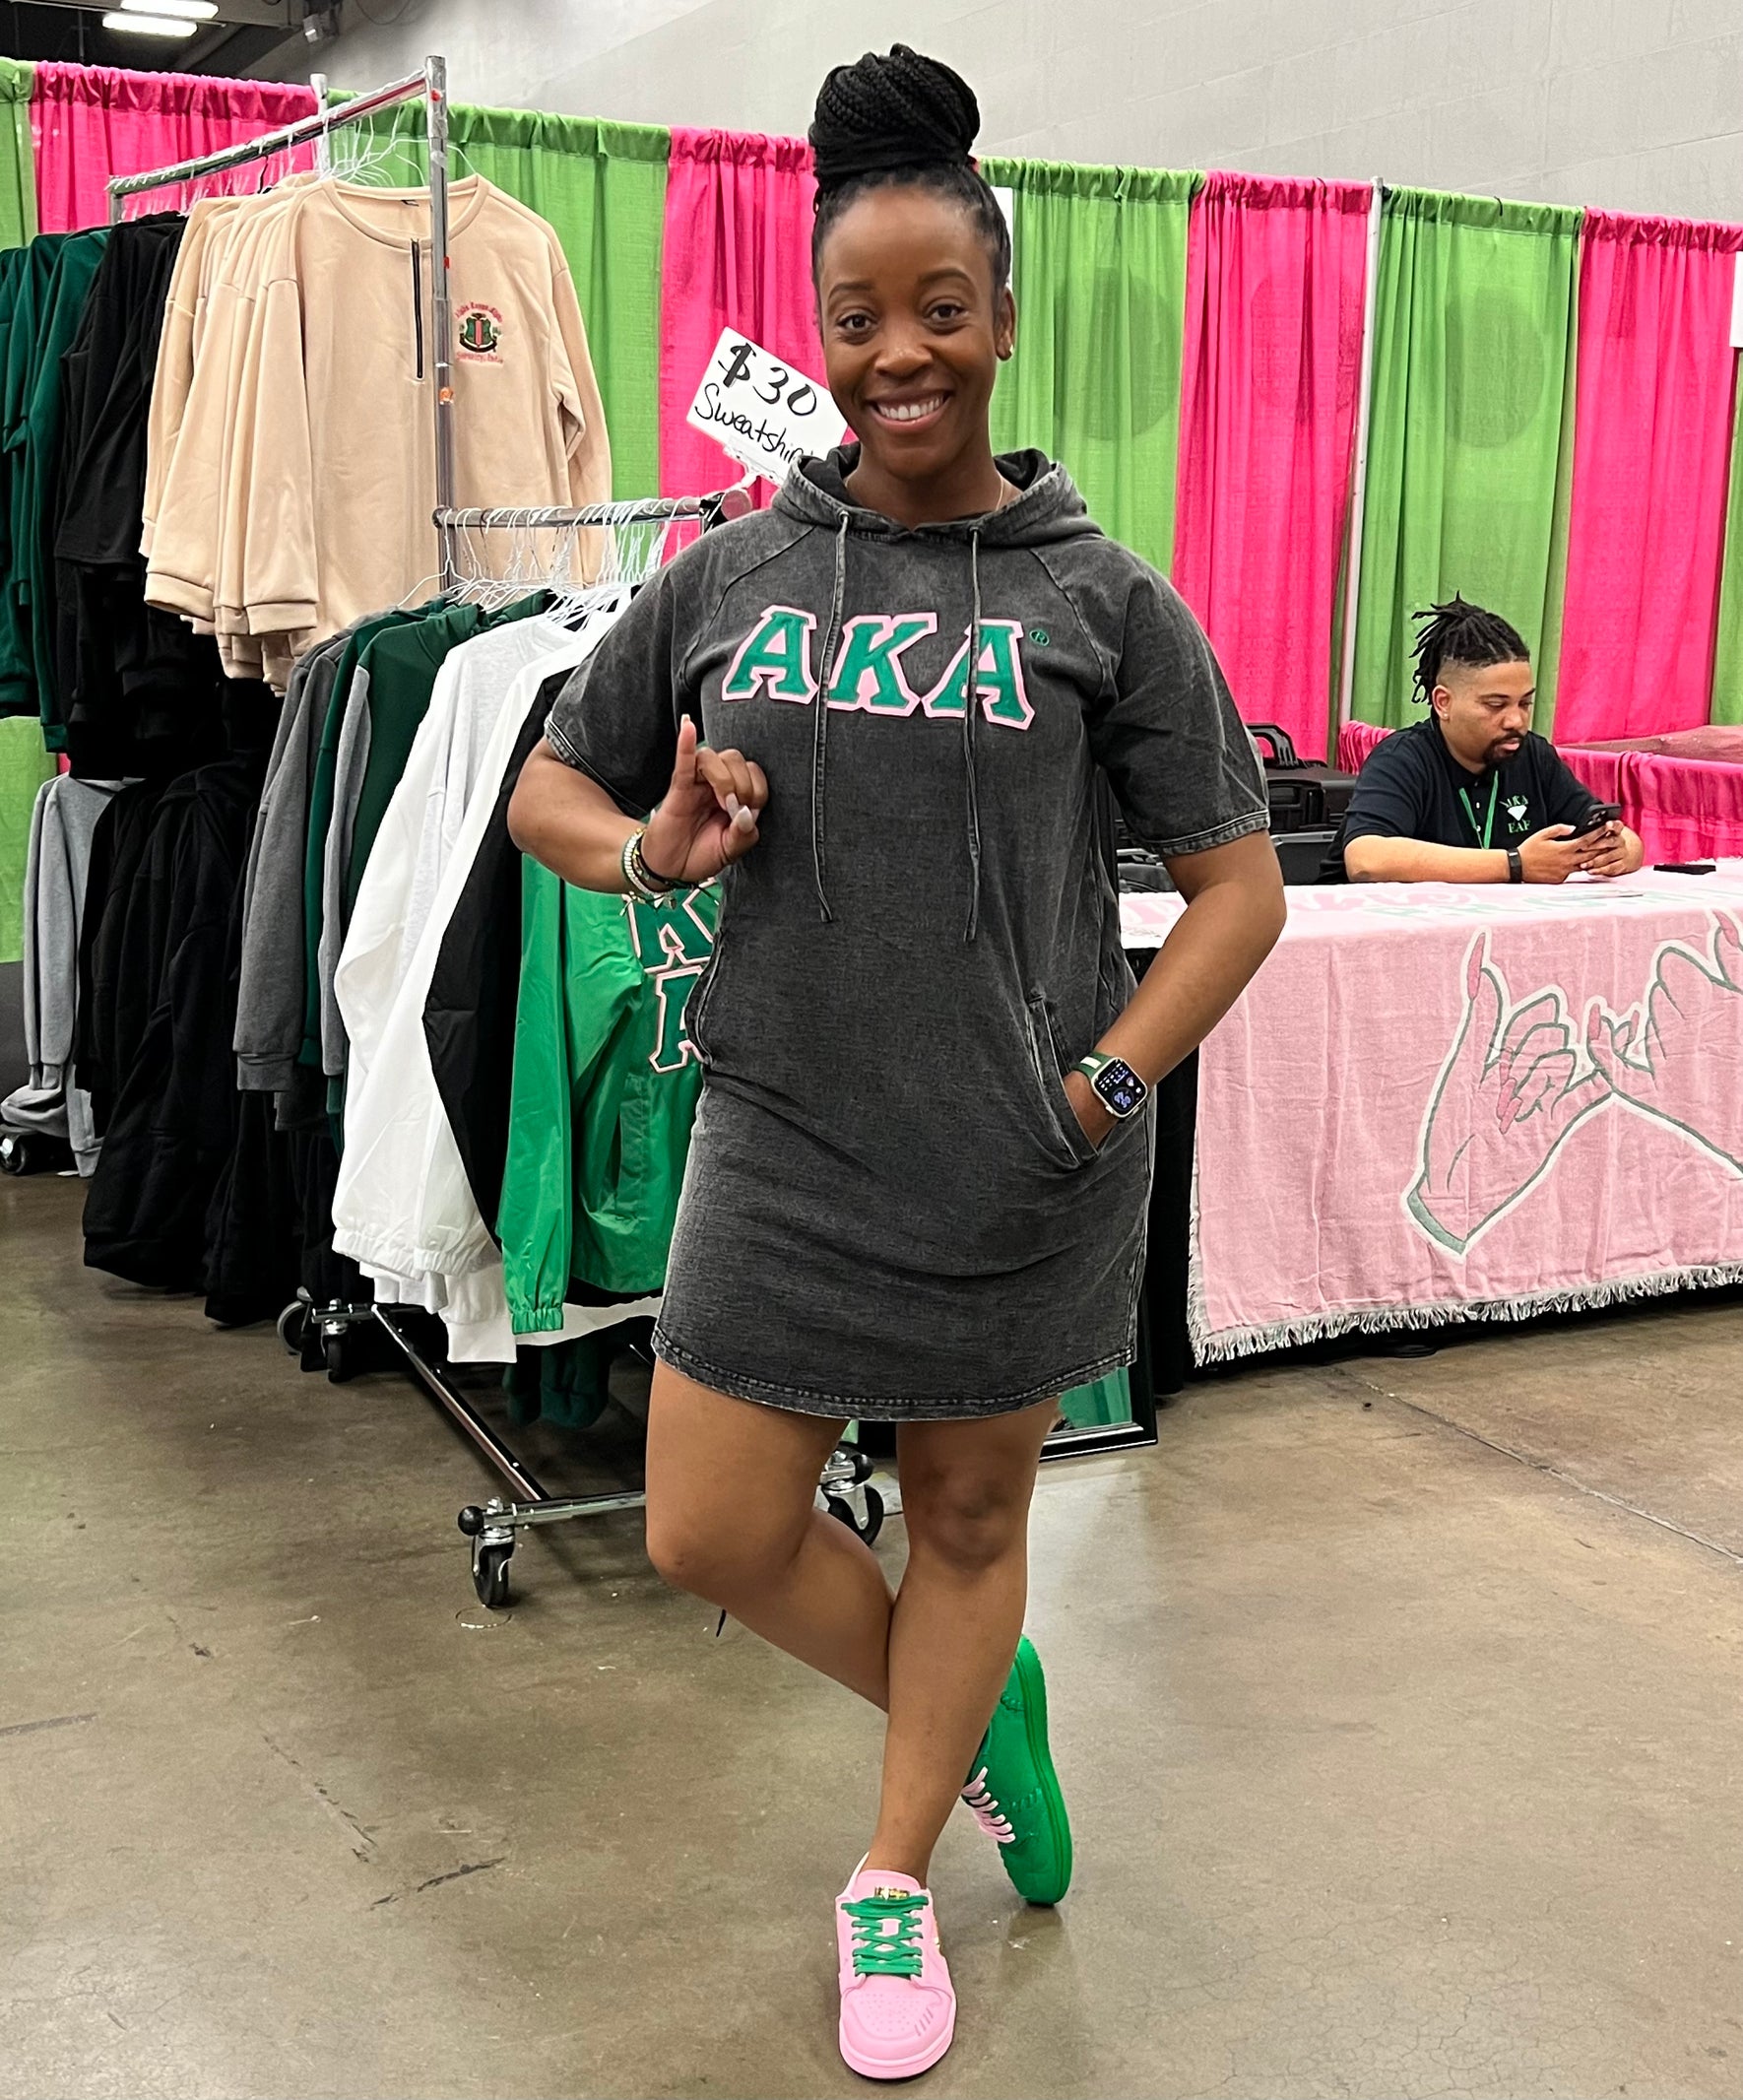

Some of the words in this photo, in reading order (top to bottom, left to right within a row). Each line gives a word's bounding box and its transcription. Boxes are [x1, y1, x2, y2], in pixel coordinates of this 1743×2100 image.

[718, 343, 817, 417] $30
[694, 382, 813, 464] Sweatshir
[721, 604, 1036, 731] AKA
